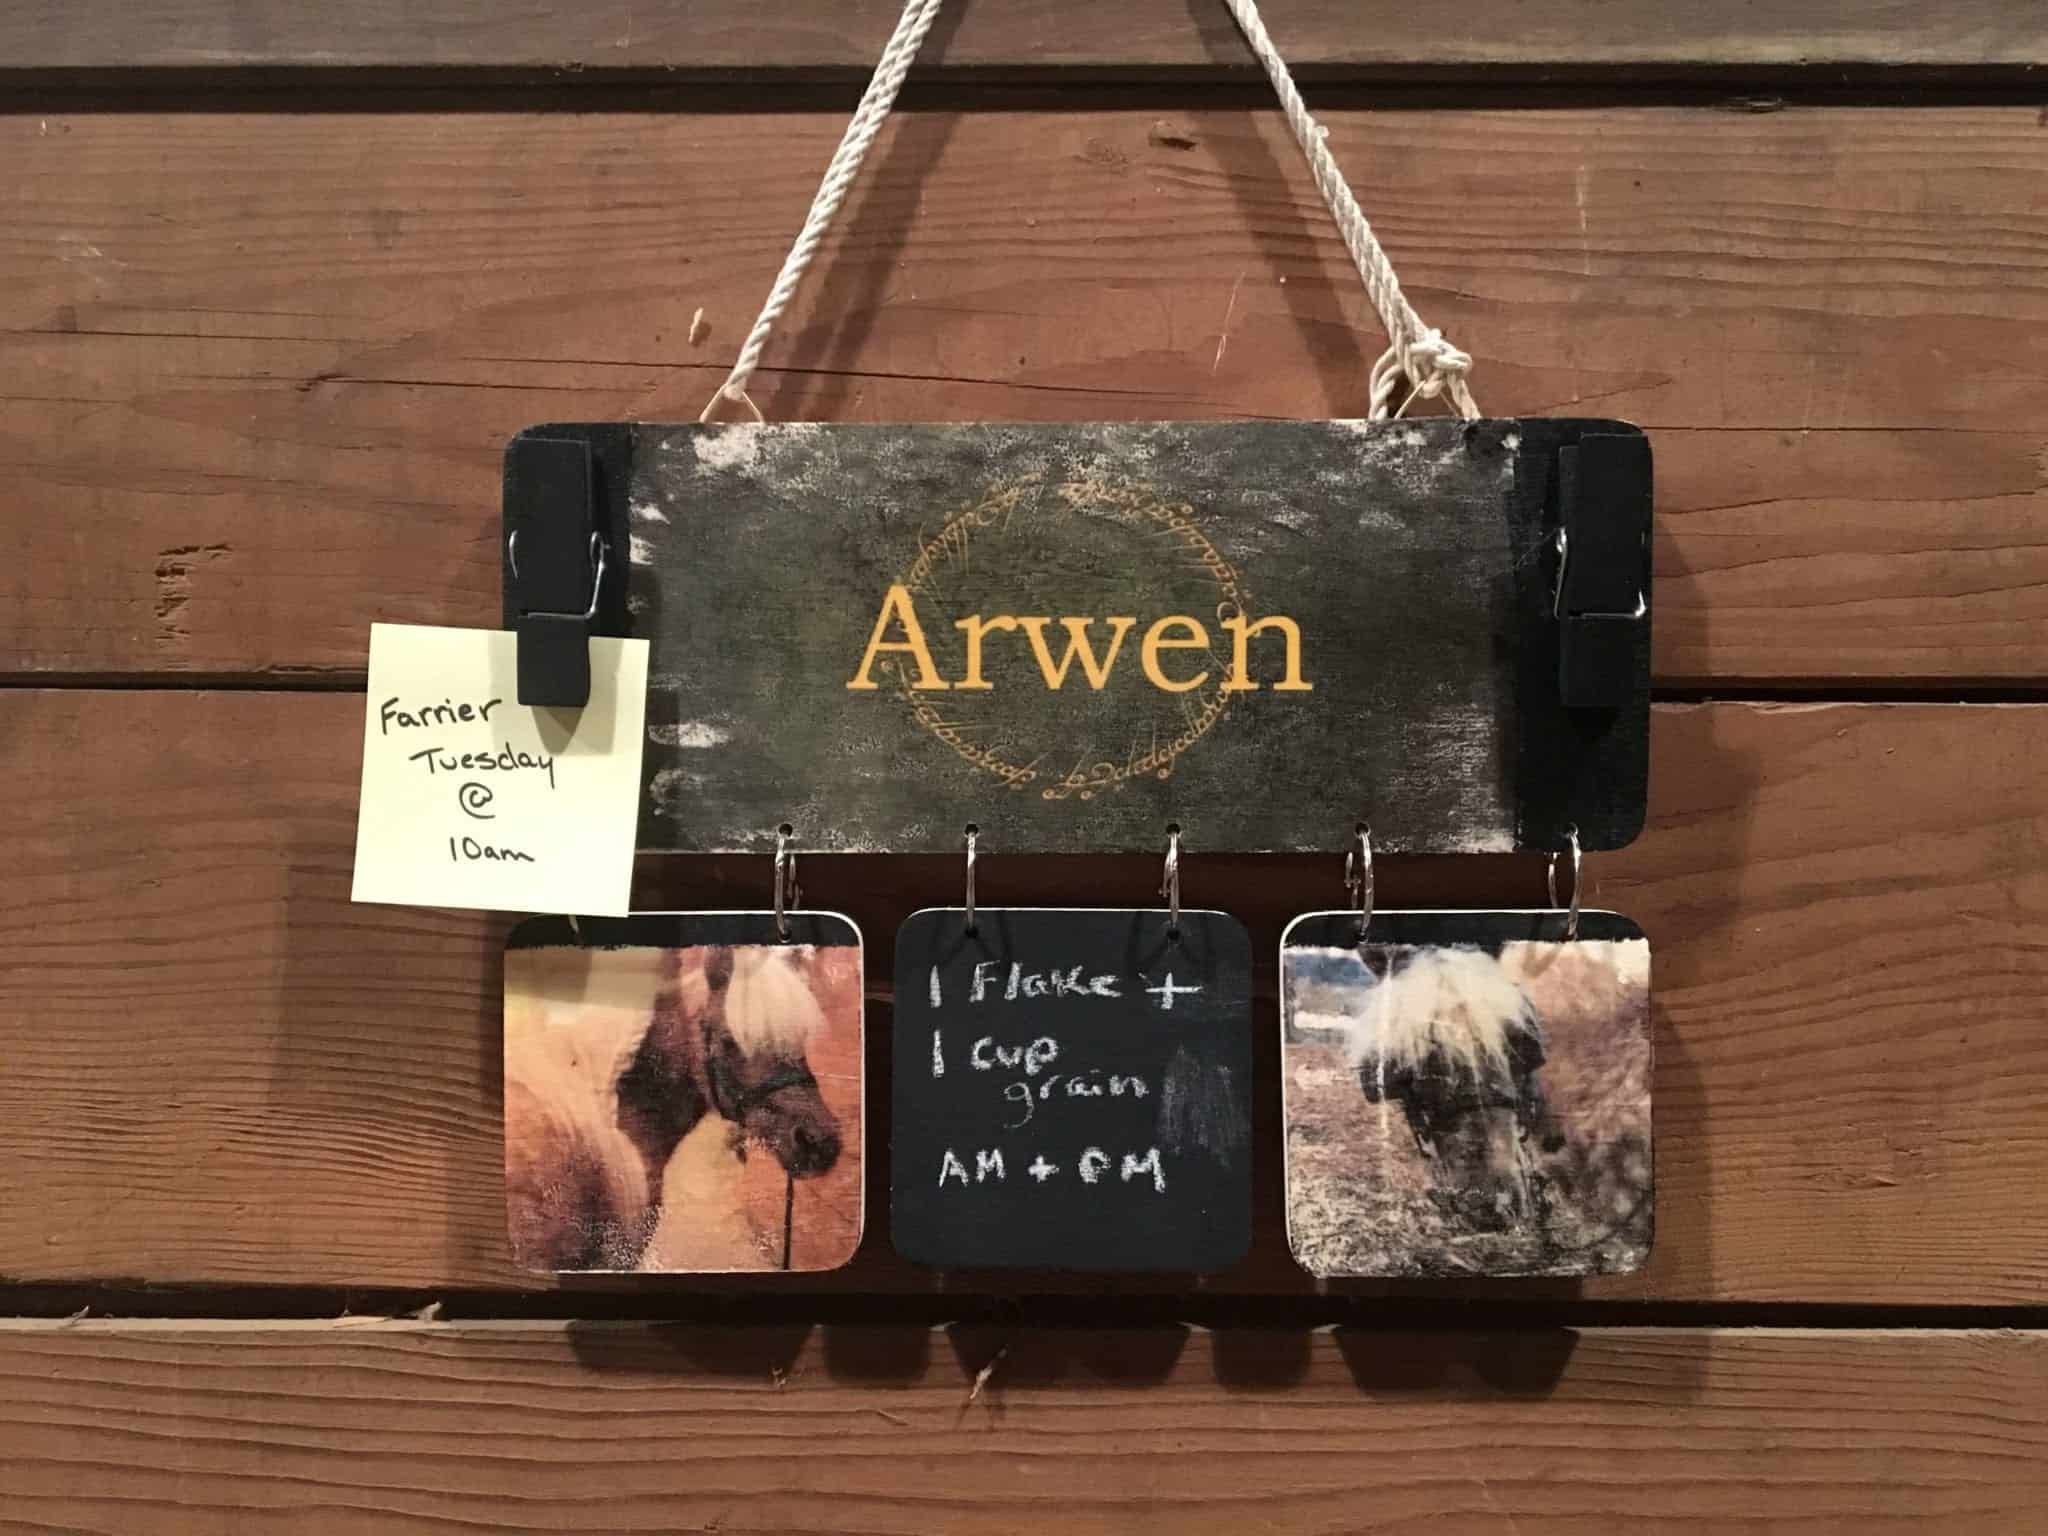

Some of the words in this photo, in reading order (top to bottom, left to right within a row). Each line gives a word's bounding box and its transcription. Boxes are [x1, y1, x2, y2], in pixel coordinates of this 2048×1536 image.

[846, 584, 1313, 691] Arwen
[380, 697, 502, 736] Farrier
[408, 742, 556, 789] Tuesday
[458, 782, 496, 819] @
[449, 837, 535, 862] 10am
[929, 965, 942, 1008] 1
[1145, 971, 1204, 1010] +
[932, 1029, 945, 1078] 1
[1002, 1069, 1149, 1128] grain
[938, 1147, 1006, 1187] AM
[1027, 1155, 1060, 1183] +
[1077, 1146, 1166, 1193] PM
